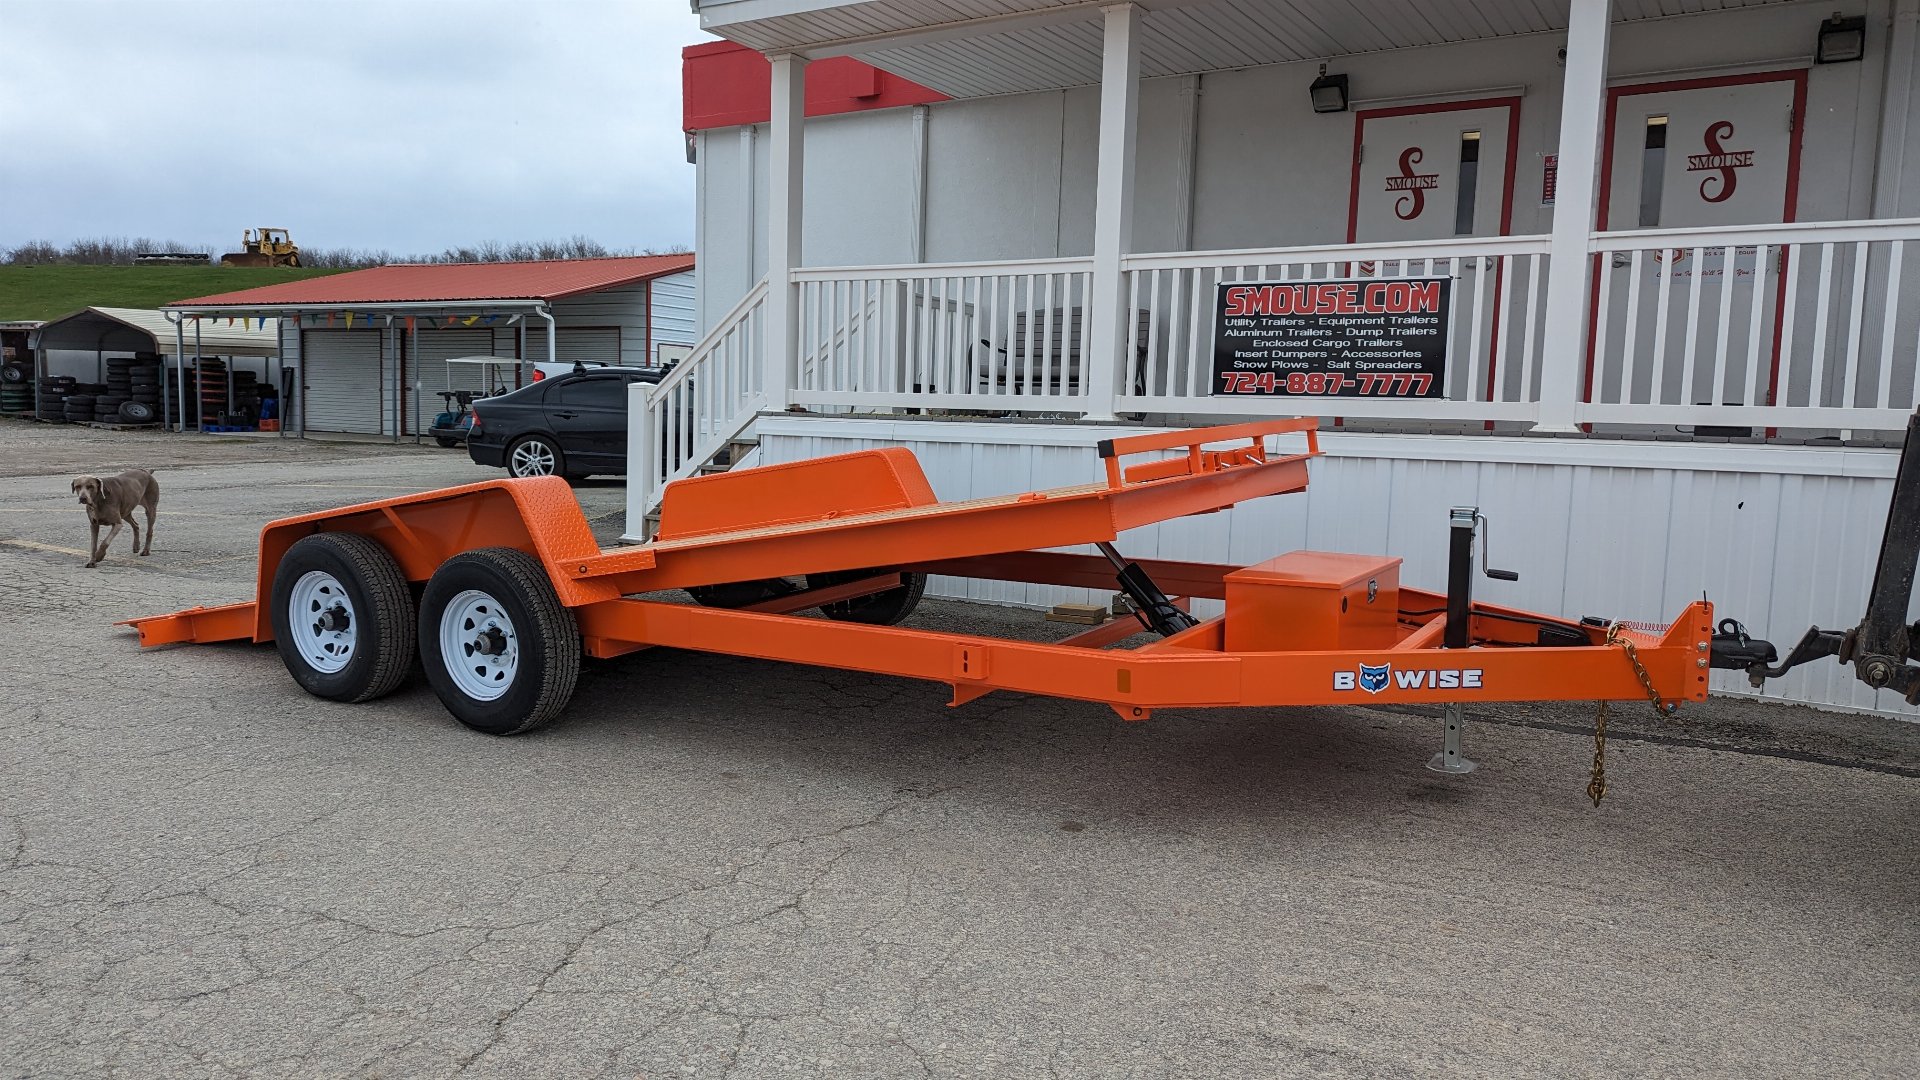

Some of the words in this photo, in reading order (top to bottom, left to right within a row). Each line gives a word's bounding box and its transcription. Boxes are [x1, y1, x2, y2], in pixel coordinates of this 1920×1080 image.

[1687, 152, 1753, 170] SMOUSE
[1385, 175, 1439, 191] SMOUSE
[1225, 282, 1440, 316] SMOUSE.COM
[1225, 318, 1256, 327] Utility
[1260, 317, 1305, 326] Trailers
[1318, 316, 1384, 326] Equipment
[1389, 315, 1439, 324] Trailers
[1224, 328, 1283, 337] Aluminum
[1287, 328, 1333, 336] Trailers
[1346, 327, 1383, 336] Dump
[1388, 326, 1437, 335] Trailers
[1253, 339, 1308, 347] Enclosed
[1312, 339, 1350, 348] Cargo
[1355, 338, 1403, 347] Trailers
[1235, 350, 1268, 358] Insert
[1272, 350, 1327, 359] Dumpers
[1341, 349, 1422, 358] Accessories
[1233, 360, 1267, 369] Snow
[1271, 360, 1309, 369] Plows
[1327, 360, 1351, 369] Salt
[1355, 360, 1422, 370] Spreaders
[1221, 372, 1434, 395] 724-887-7777
